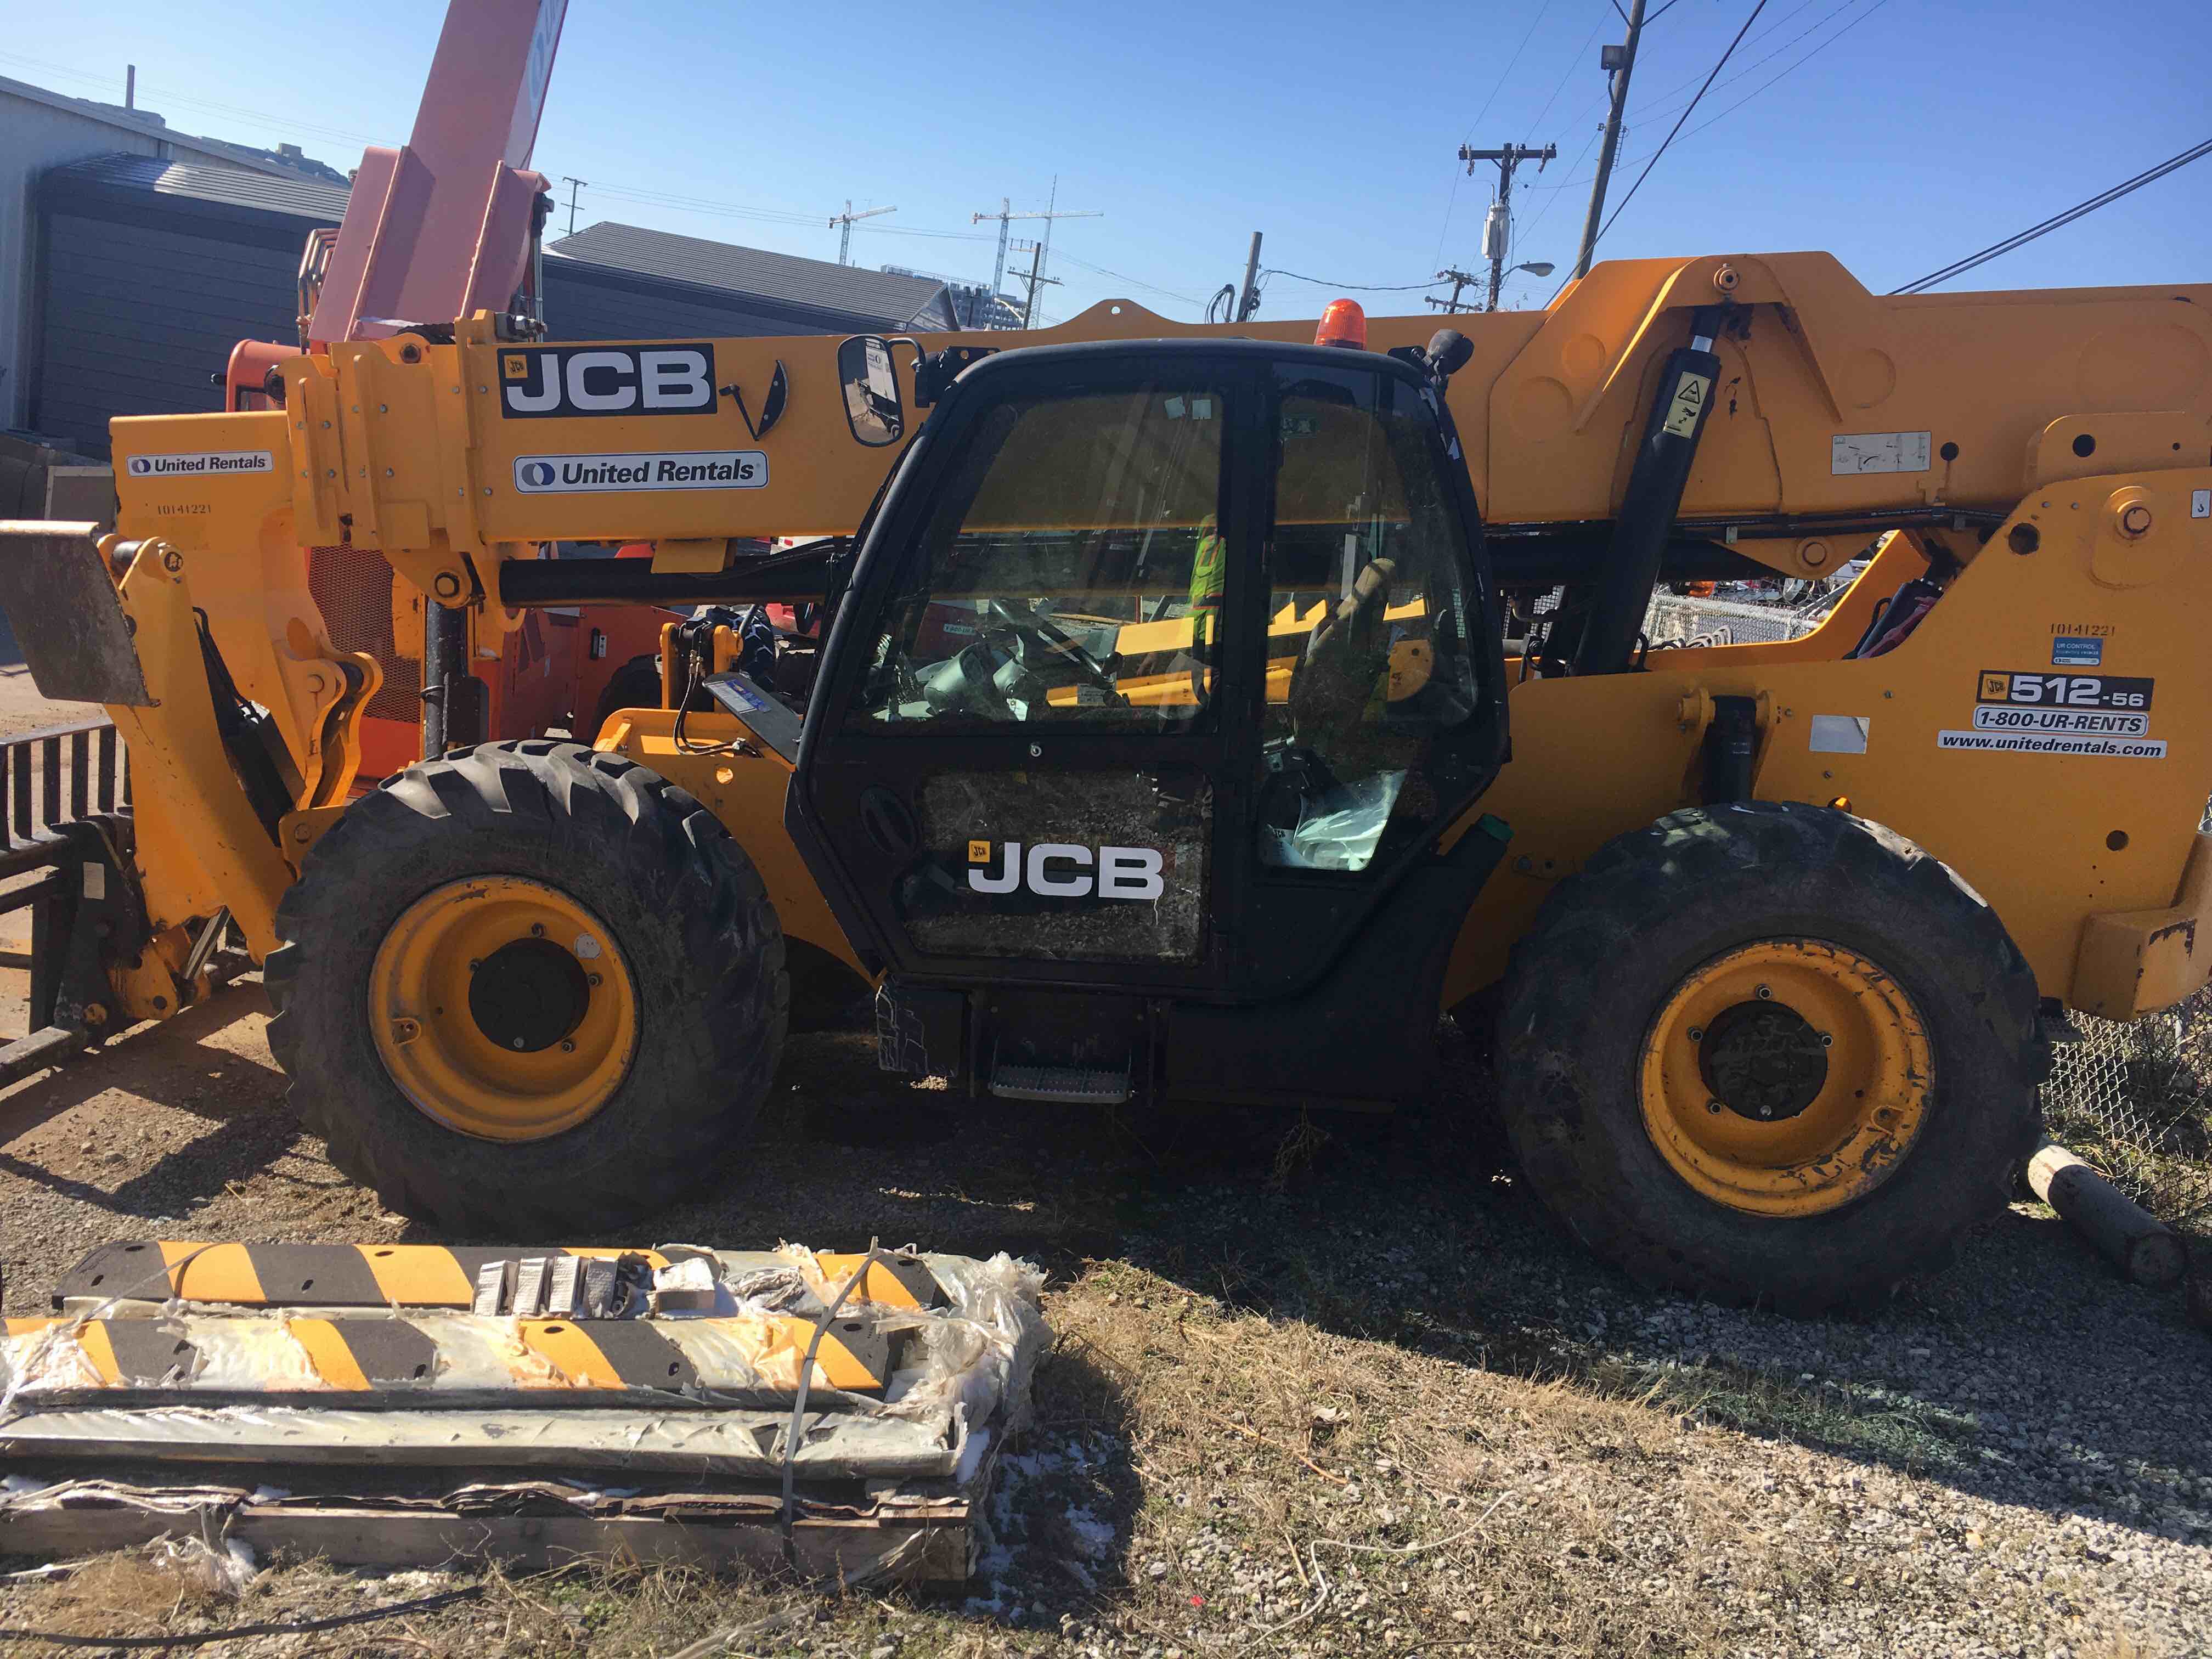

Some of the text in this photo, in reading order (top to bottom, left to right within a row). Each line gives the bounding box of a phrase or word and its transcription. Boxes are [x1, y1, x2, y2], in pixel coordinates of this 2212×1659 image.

[506, 351, 710, 411] JCB
[155, 455, 266, 472] United Rentals
[562, 459, 754, 483] United Rentals
[157, 504, 211, 514] 10141221
[2051, 623, 2115, 636] 10141221
[1987, 680, 2005, 693] JCB
[1980, 712, 2142, 732] 1-800-UR-RENTS
[1943, 736, 2161, 757] www.unitedrentals.com
[968, 842, 1164, 900] JCB
